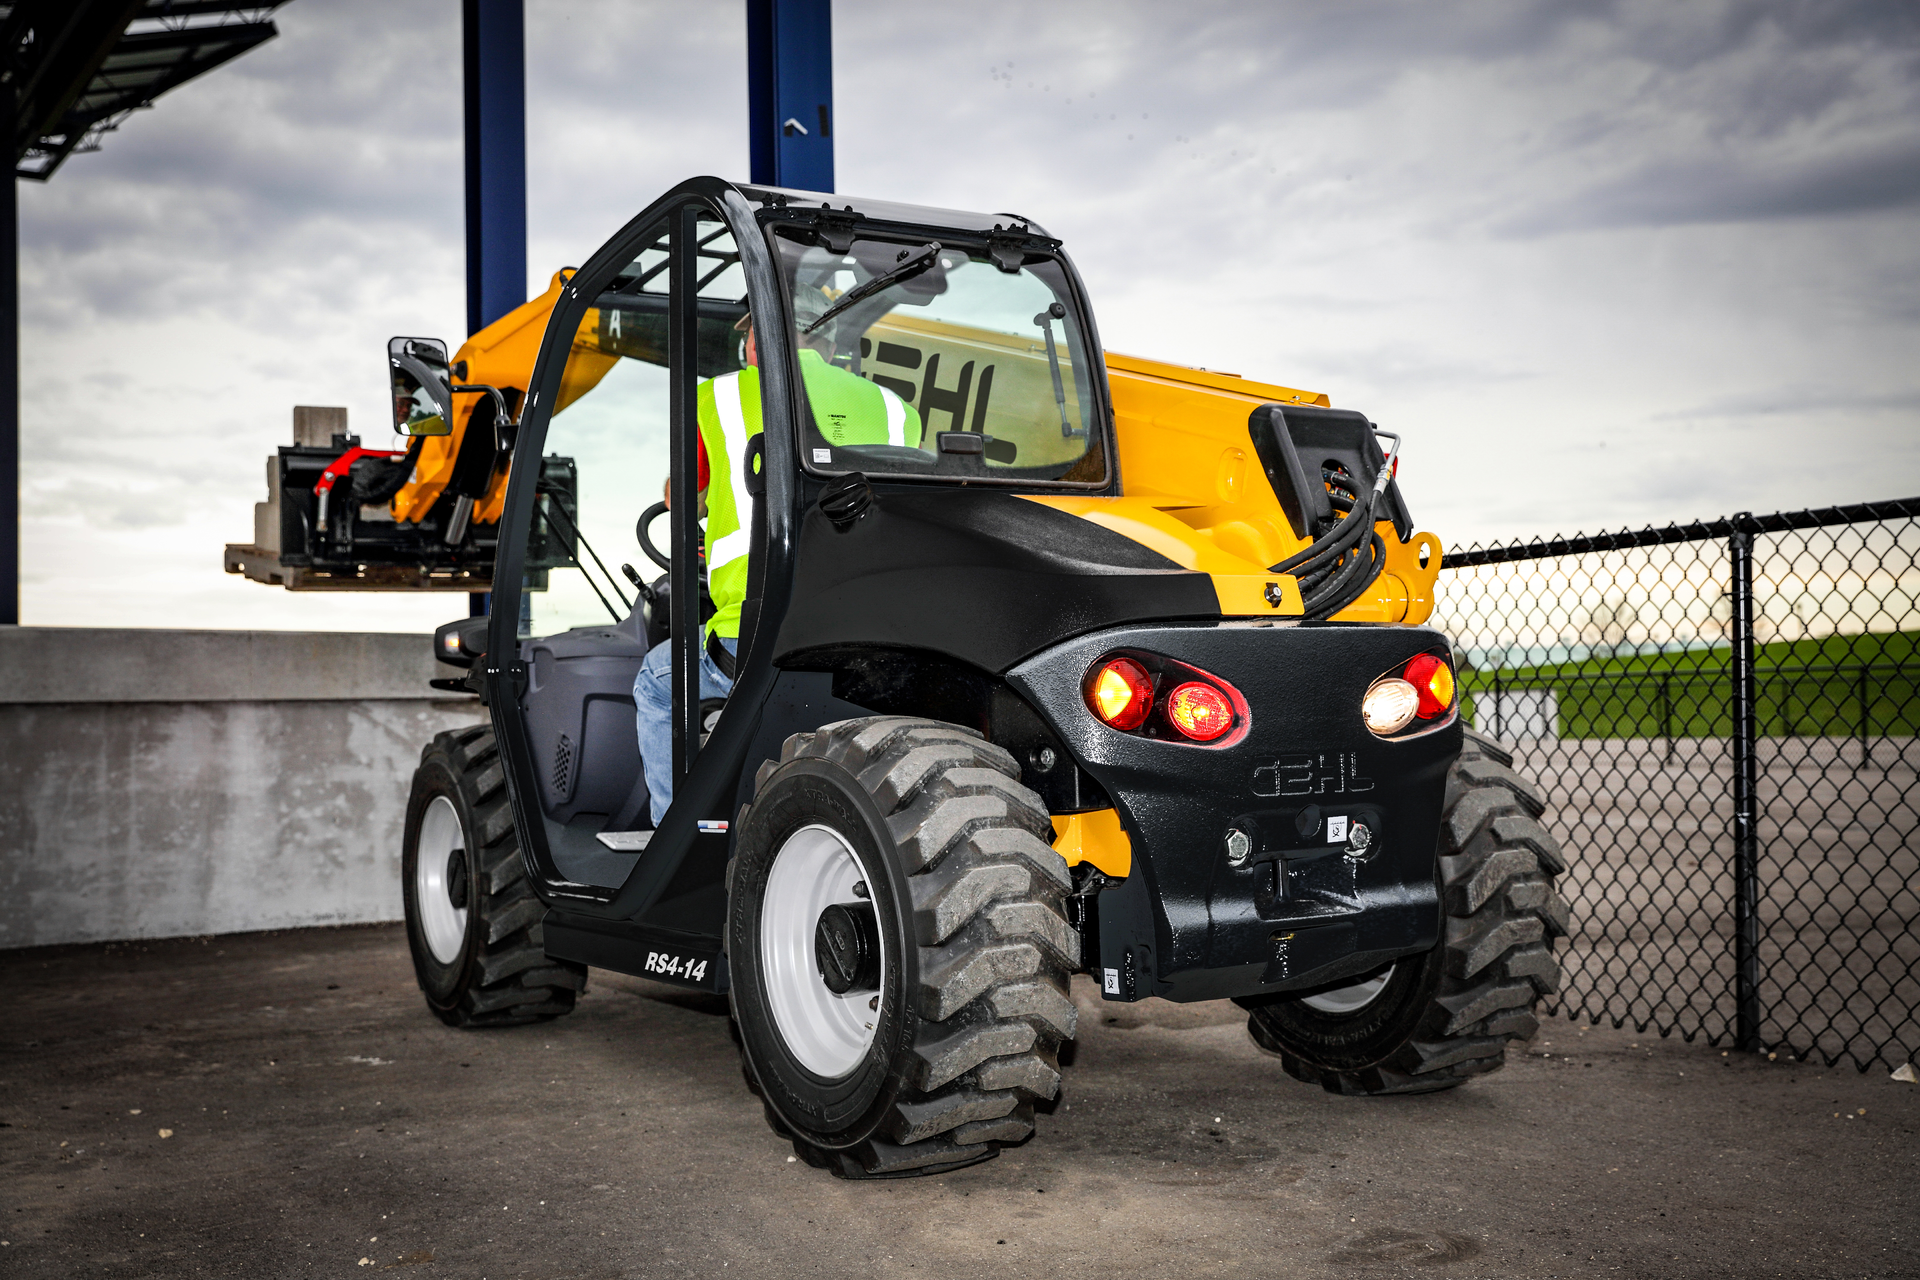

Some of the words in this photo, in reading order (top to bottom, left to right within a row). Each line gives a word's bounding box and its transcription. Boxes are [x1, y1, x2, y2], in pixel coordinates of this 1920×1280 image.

[861, 337, 1017, 464] EHL
[1251, 752, 1375, 797] GEHL
[644, 951, 708, 982] RS4-14
